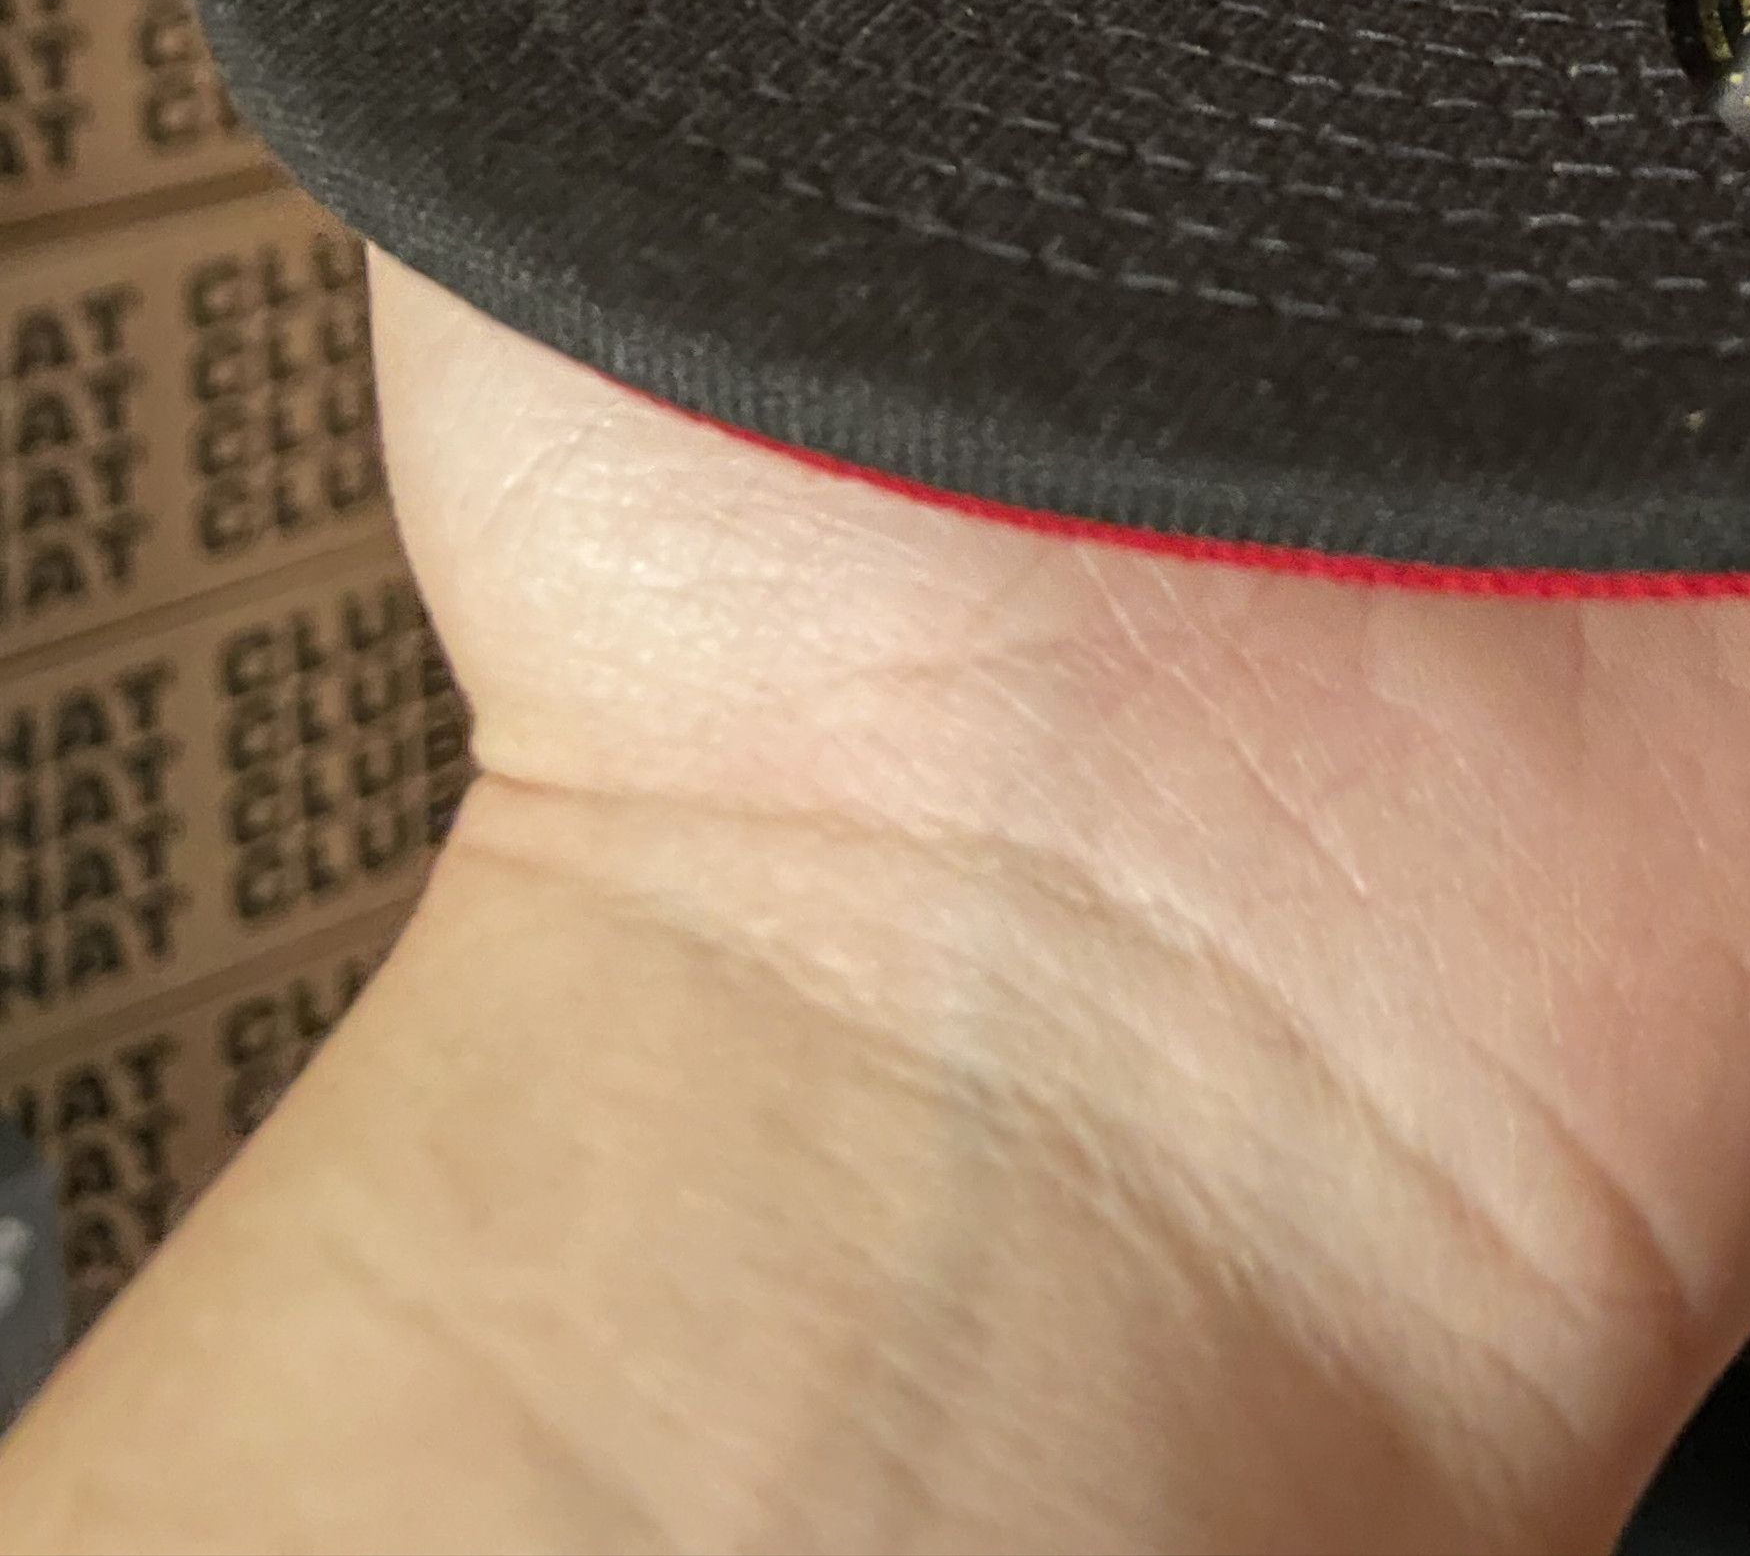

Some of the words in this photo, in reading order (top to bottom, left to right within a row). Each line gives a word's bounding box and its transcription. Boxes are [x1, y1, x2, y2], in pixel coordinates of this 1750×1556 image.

[188, 234, 367, 328] CLU
[191, 317, 373, 399] CLU
[192, 389, 379, 475] CLU
[196, 451, 391, 552] CLU
[221, 586, 403, 695] CLU
